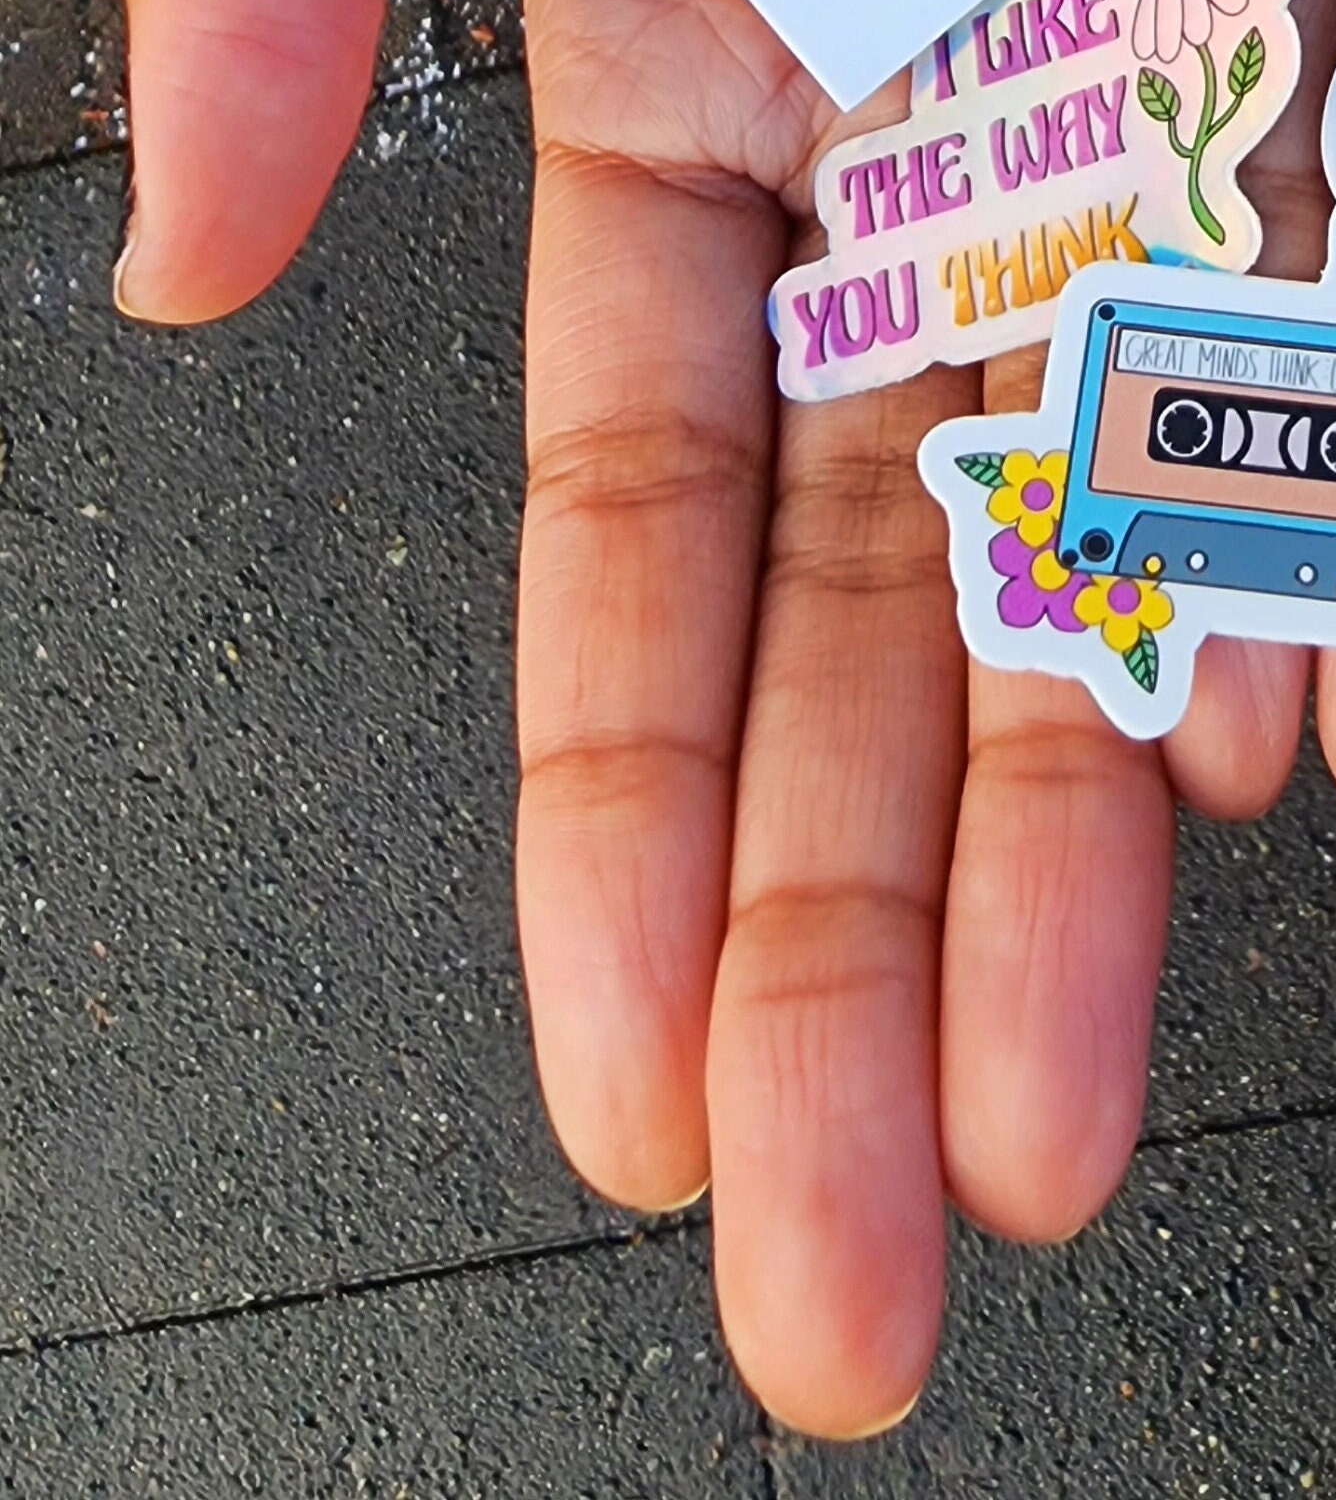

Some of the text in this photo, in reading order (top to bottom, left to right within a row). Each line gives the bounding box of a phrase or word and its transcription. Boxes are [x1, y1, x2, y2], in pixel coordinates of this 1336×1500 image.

[933, 31, 957, 102] I
[839, 75, 1127, 239] THE WAY
[792, 192, 1151, 369] YOU THINK
[1125, 335, 1187, 373] GREAT
[1197, 344, 1259, 380] MINDS
[1269, 350, 1321, 388] THINK
